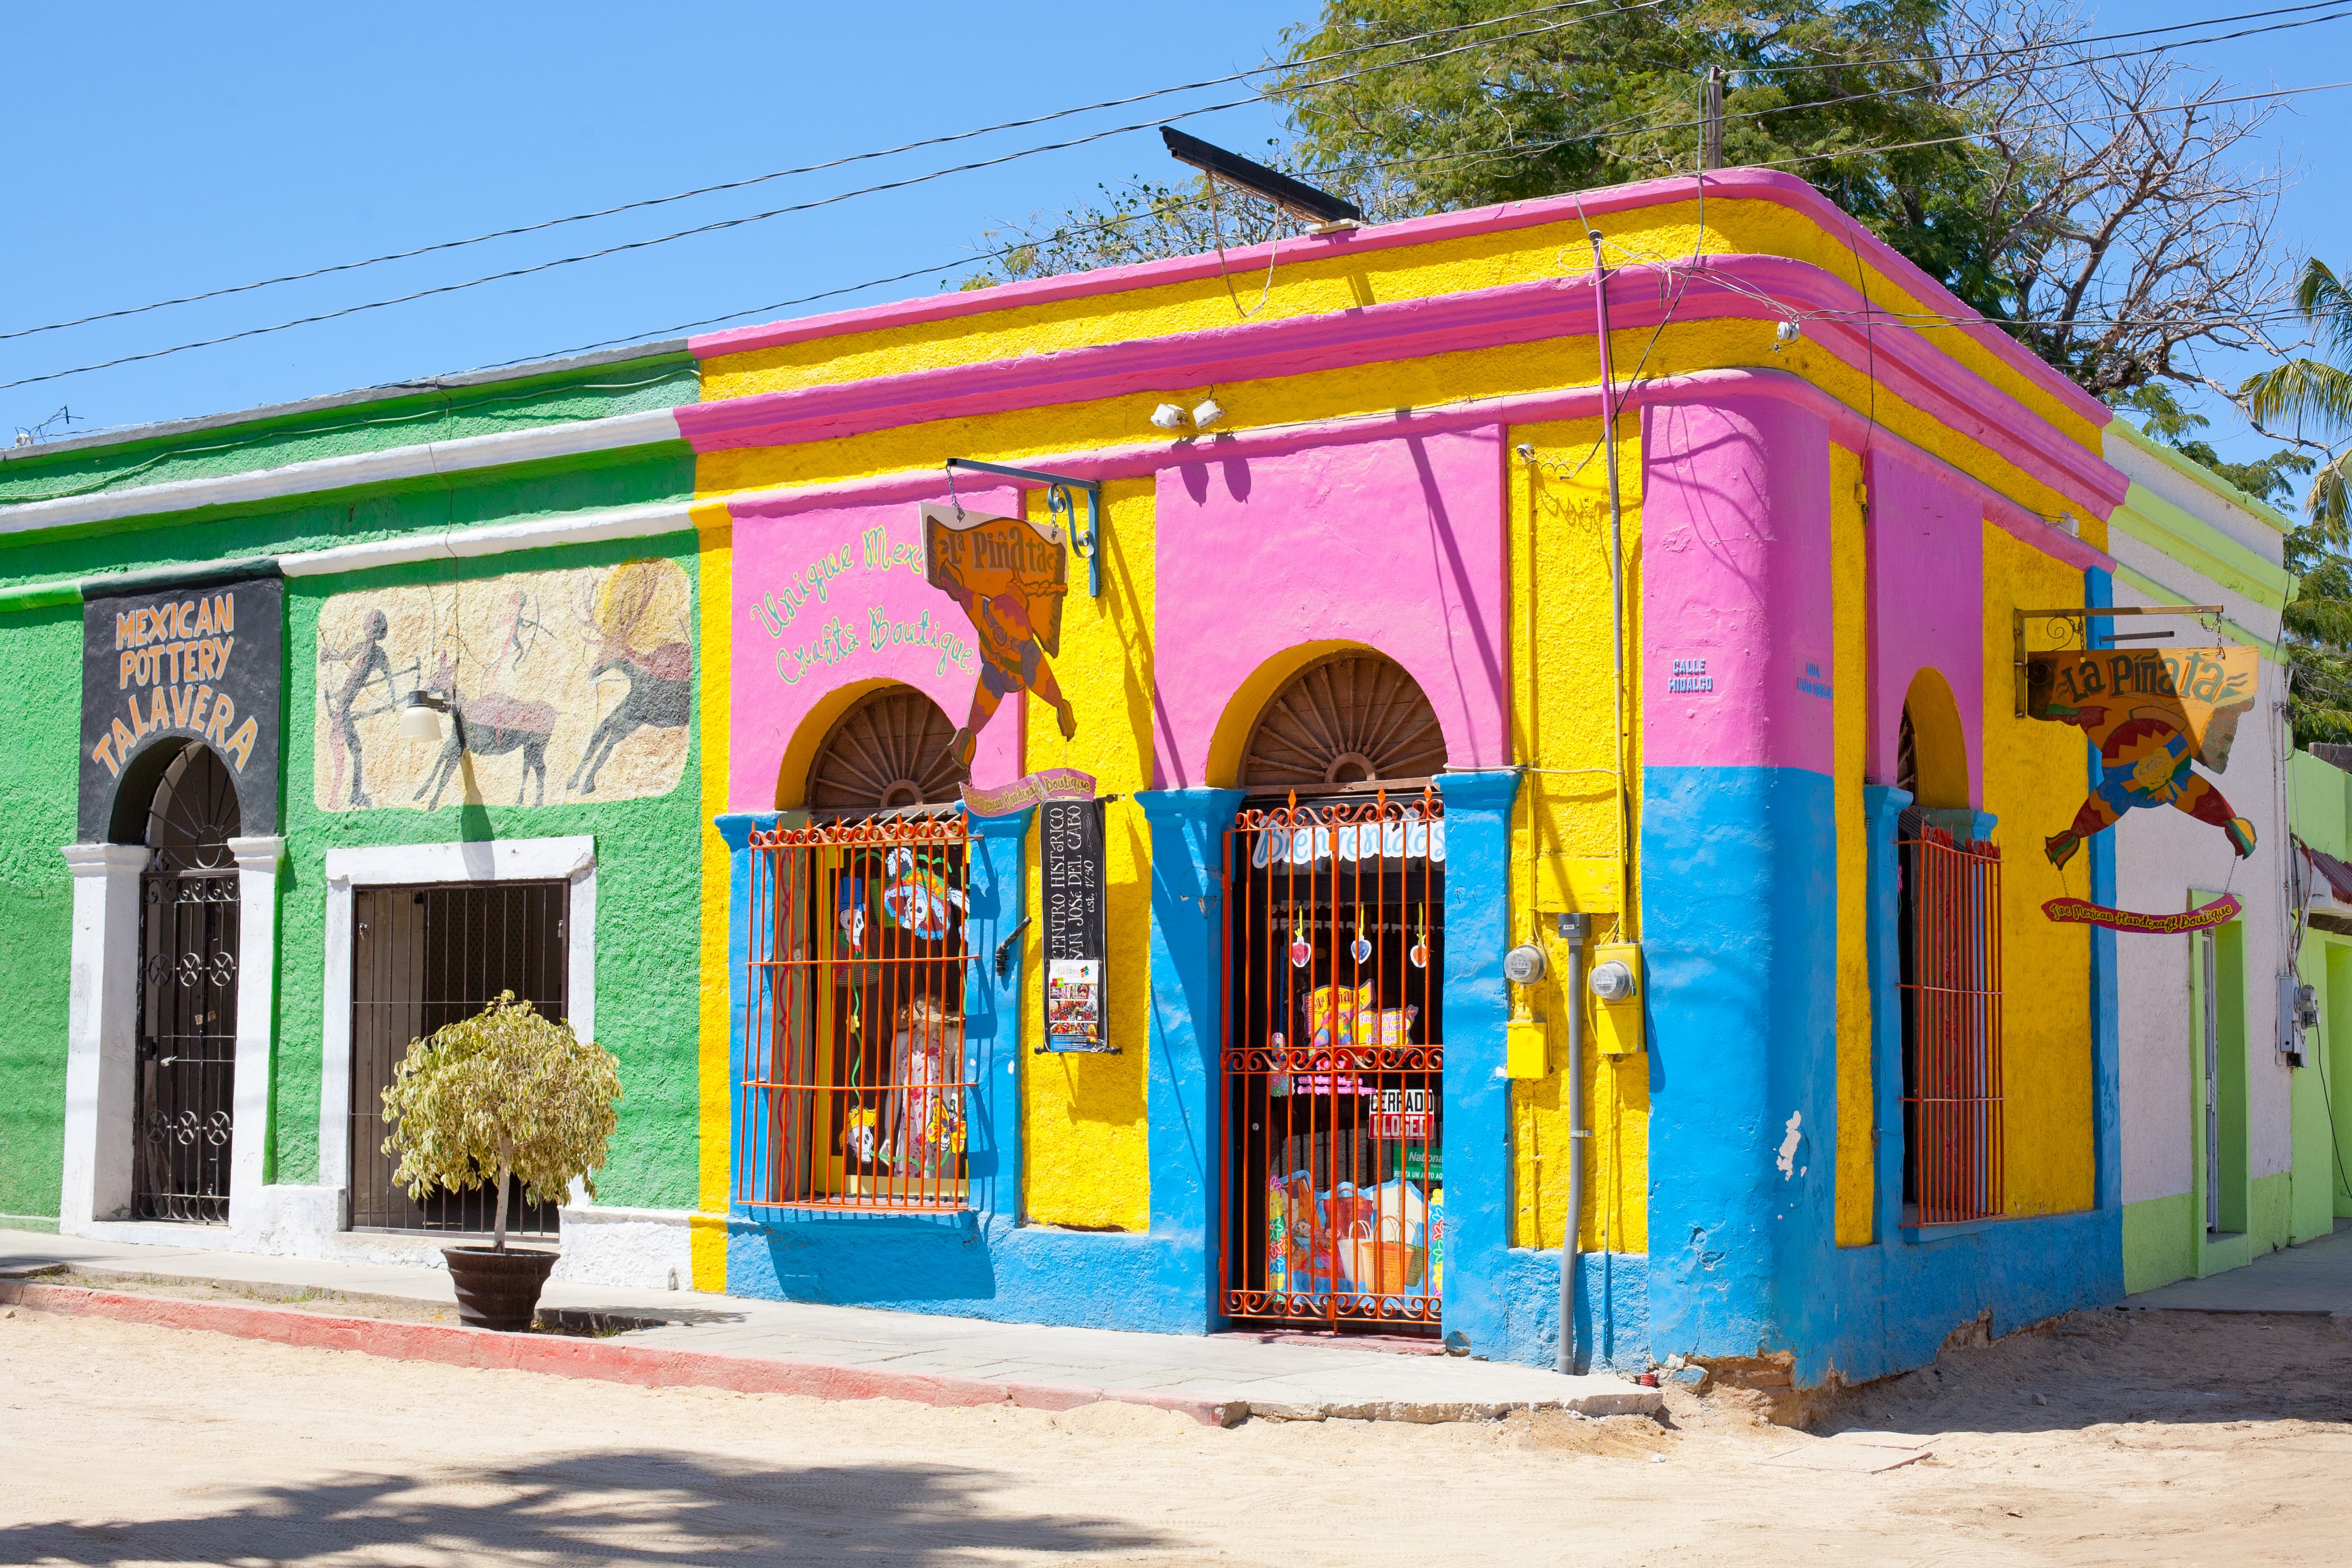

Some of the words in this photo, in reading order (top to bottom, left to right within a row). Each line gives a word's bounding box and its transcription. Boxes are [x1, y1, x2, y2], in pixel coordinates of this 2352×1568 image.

[946, 533, 965, 565] La
[970, 526, 1048, 574] Piñata
[750, 543, 854, 638] Unique
[116, 593, 234, 650] MEXICAN
[120, 636, 234, 689] POTTERY
[776, 615, 860, 684] Crafts
[1673, 659, 1706, 676] CALLE
[1668, 676, 1713, 693] HIDALGO
[2061, 661, 2106, 703] La
[2108, 651, 2225, 704] Piñata
[92, 684, 258, 778] TALAVERA
[1042, 774, 1091, 794] Boutique
[1067, 806, 1082, 850] CABO
[1068, 855, 1082, 886] DEL
[1083, 860, 1095, 888] 1730
[1051, 894, 1066, 960] CENTRO
[2050, 904, 2073, 920] Fine
[2073, 905, 2113, 921] Mexican
[2115, 911, 2179, 934] Handcraft
[2180, 904, 2234, 929] Boutique
[1069, 931, 1083, 961] SAN
[1408, 1152, 1443, 1163] Natona
